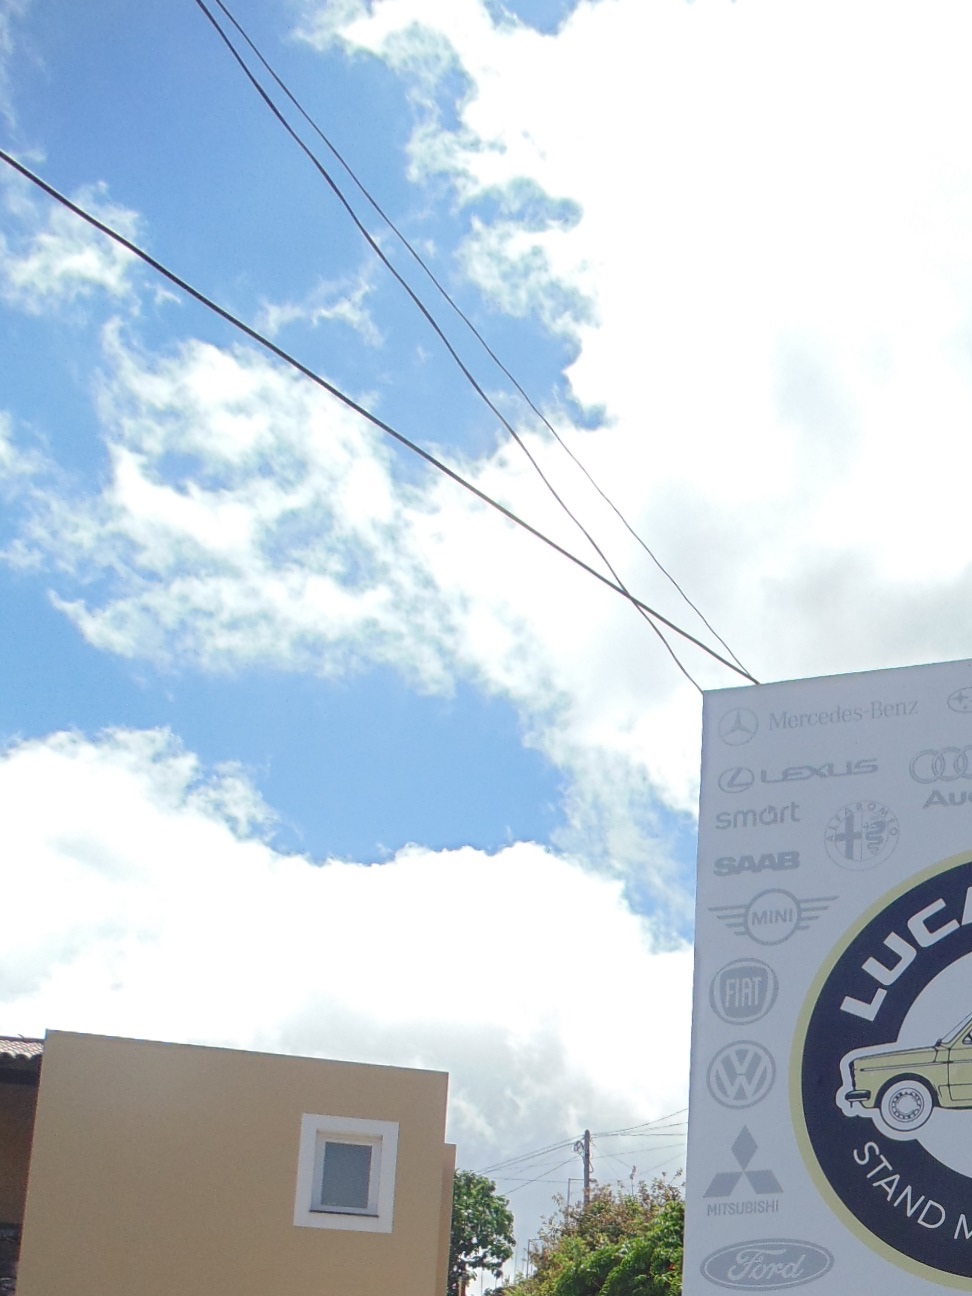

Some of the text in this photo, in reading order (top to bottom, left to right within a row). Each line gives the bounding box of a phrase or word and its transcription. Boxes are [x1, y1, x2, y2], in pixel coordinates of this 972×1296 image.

[768, 700, 919, 732] Mercedes-Benz
[760, 758, 879, 784] LEXUS
[714, 801, 802, 830] smart
[712, 851, 801, 877] SAAB
[750, 908, 795, 926] MINI
[723, 976, 763, 1009] FIAT
[853, 1141, 946, 1229] STAND
[706, 1200, 780, 1217] MITSUBISHI
[727, 1249, 806, 1281] Ford
